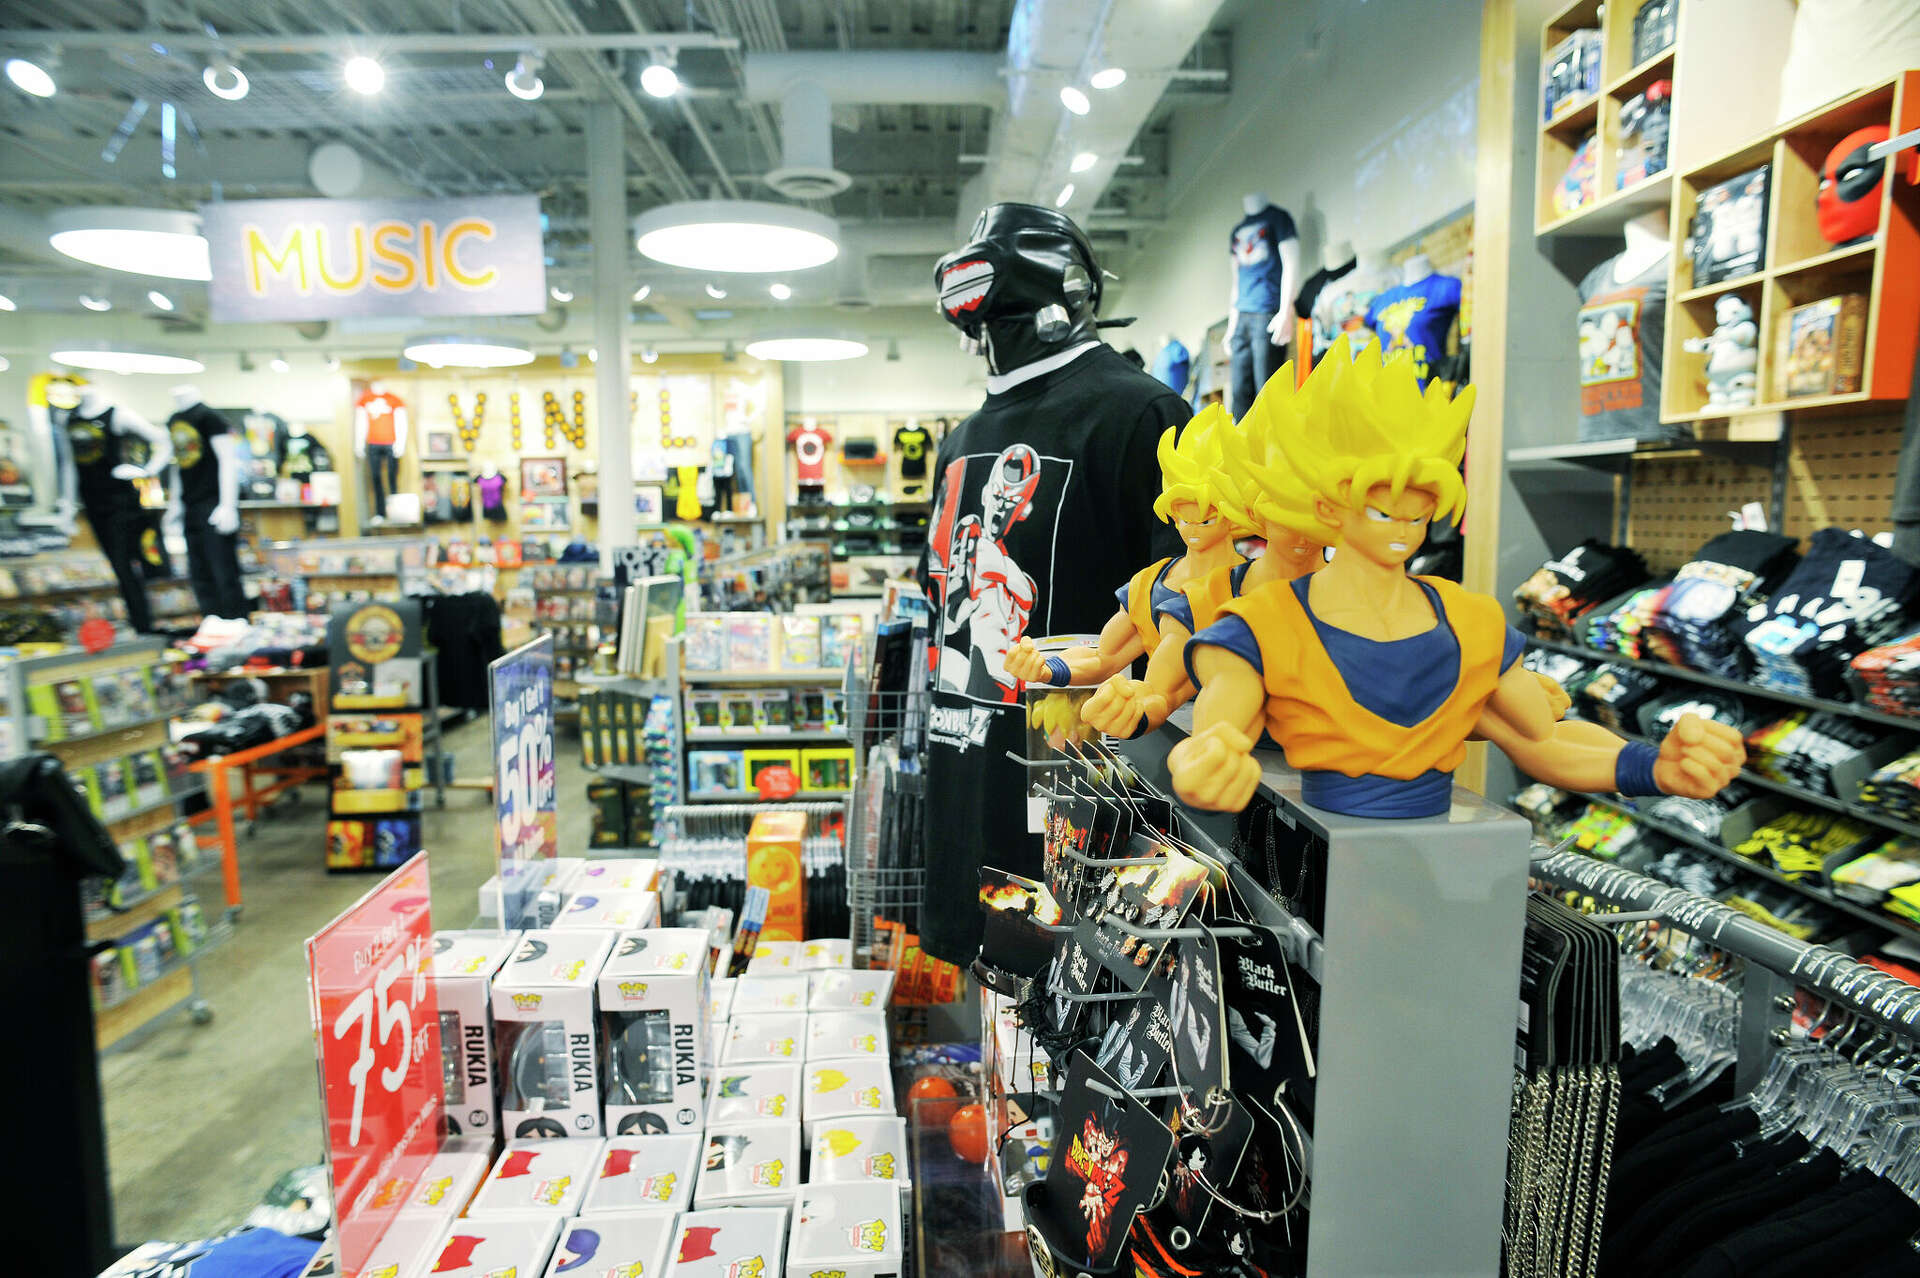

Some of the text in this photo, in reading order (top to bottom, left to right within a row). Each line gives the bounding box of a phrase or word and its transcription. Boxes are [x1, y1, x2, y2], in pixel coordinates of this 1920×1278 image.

[246, 218, 498, 295] MUSIC
[448, 391, 697, 451] VINL
[500, 709, 553, 846] 50%
[1238, 955, 1276, 979] Black
[1242, 972, 1287, 996] Butler
[333, 933, 427, 1148] 75%
[464, 1025, 487, 1088] RUKIA
[570, 1033, 593, 1093] RUKIA
[674, 1024, 696, 1086] RUKIA
